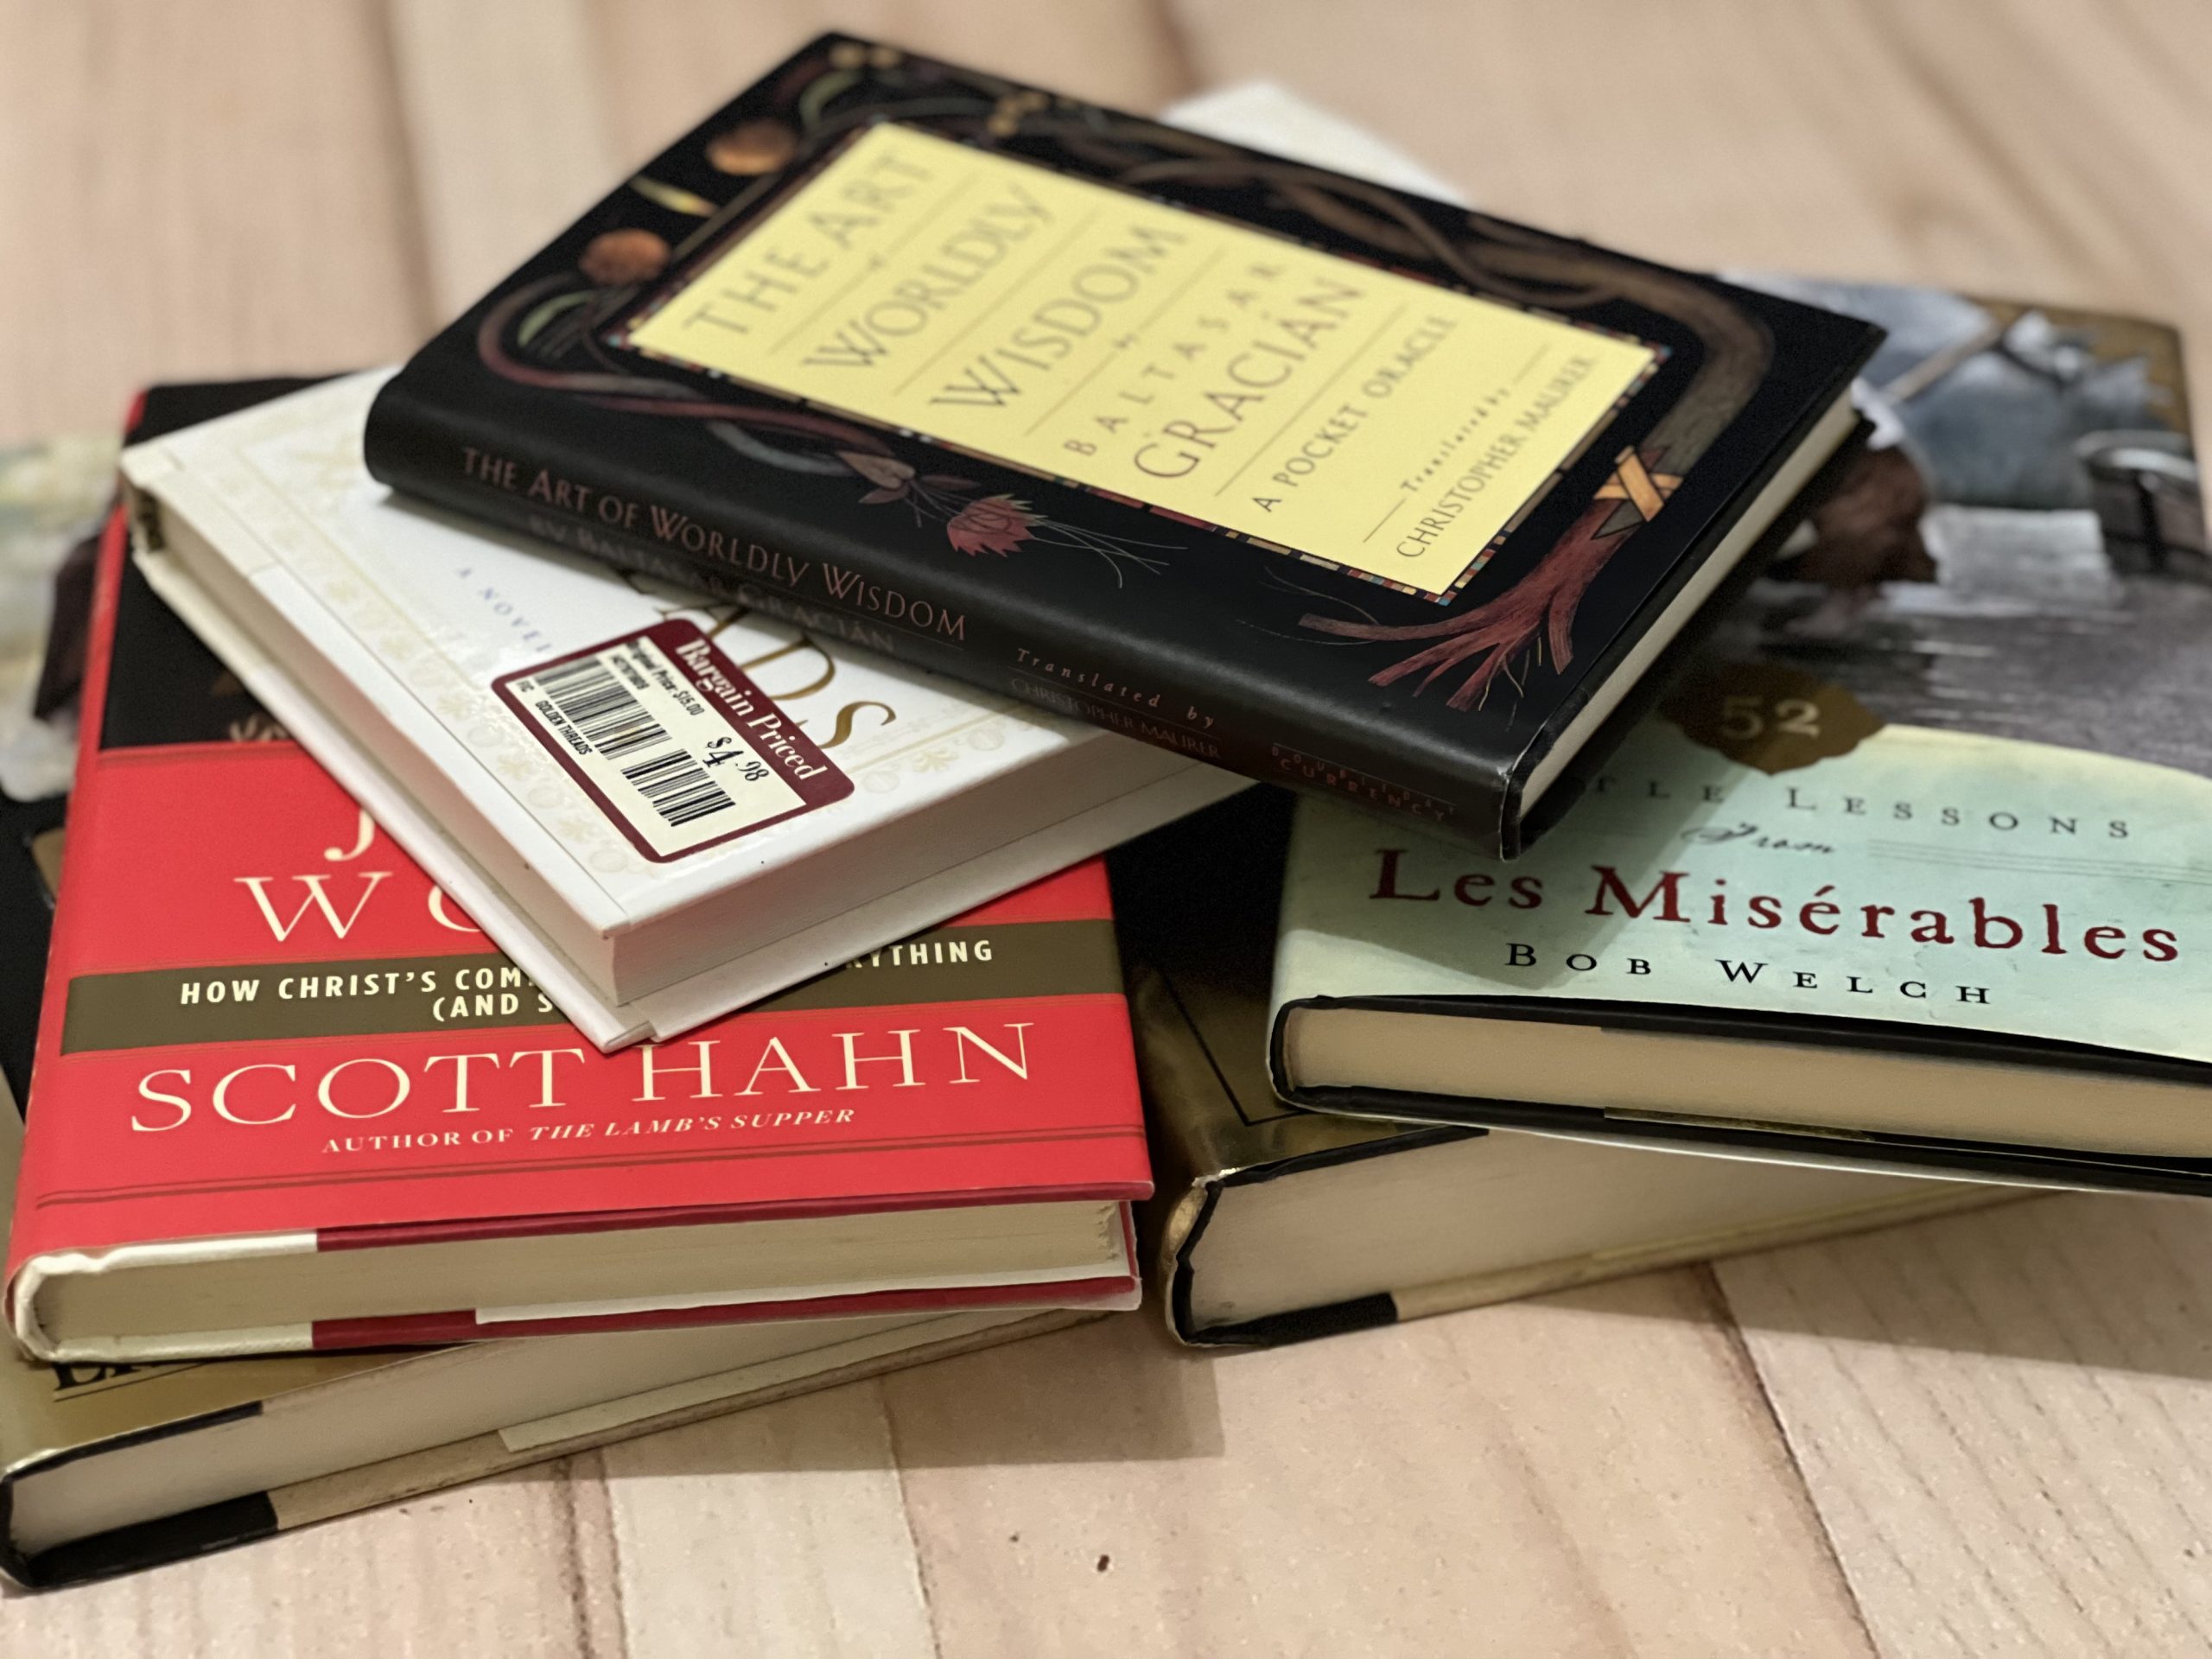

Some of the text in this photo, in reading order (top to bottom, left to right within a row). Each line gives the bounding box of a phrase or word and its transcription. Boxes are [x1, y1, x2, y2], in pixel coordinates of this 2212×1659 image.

[683, 245, 830, 335] THE
[801, 181, 1056, 368] WORLDLY
[929, 221, 1188, 410] WISDOM
[1064, 262, 1286, 457] BALTASAR
[1253, 312, 1457, 512] A POCKET ORACLE
[462, 447, 517, 489] THE
[650, 505, 810, 587] WORLDLY
[823, 563, 967, 642] WISDOM
[1396, 432, 1526, 557] CHRISTOPHER
[535, 700, 566, 727] GOLDEN
[558, 724, 593, 755] THREADS
[675, 638, 755, 718] Bargain
[747, 715, 829, 781] Priced
[1016, 646, 1215, 729] Translated by
[1724, 698, 1821, 741] 52
[1788, 788, 2130, 839] LESSONS
[1369, 849, 2178, 962] Les Misérables
[181, 940, 993, 1004] HOW CHRIST'S COM YTHING
[433, 994, 518, 1022] (AND
[1504, 944, 1991, 1004] BOB WELCH
[130, 1022, 1034, 1132] SCOTT HAHN
[322, 1108, 855, 1154] AUTHOR OF THE LAMB'S SUPPER
